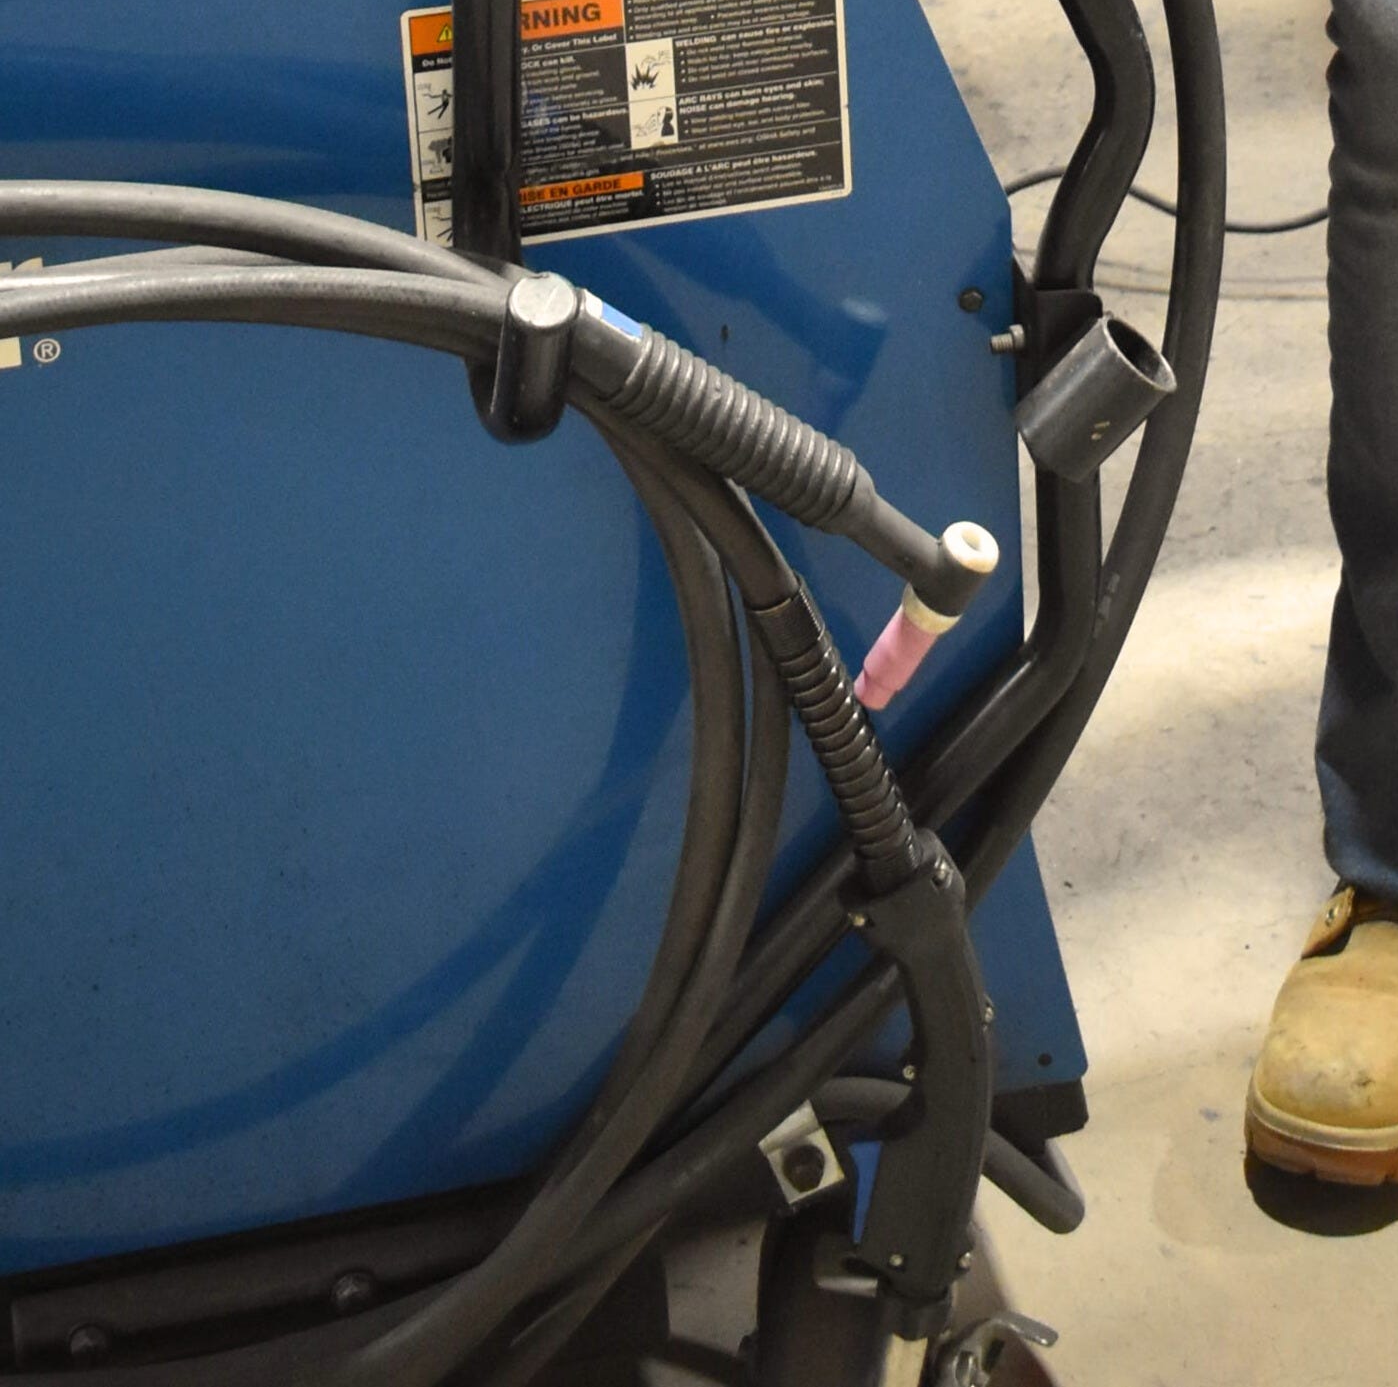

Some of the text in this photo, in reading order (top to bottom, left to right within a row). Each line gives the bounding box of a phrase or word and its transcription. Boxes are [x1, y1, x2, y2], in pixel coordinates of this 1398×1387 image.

[520, 3, 601, 30] RNING
[674, 35, 716, 48] WELDING
[521, 60, 540, 70] OCK
[678, 95, 697, 106] ARC
[699, 92, 722, 103] RAYS
[679, 103, 706, 115] NOISE
[650, 166, 693, 180] SOUDAGE
[520, 179, 621, 203] ISE EN GARDE
